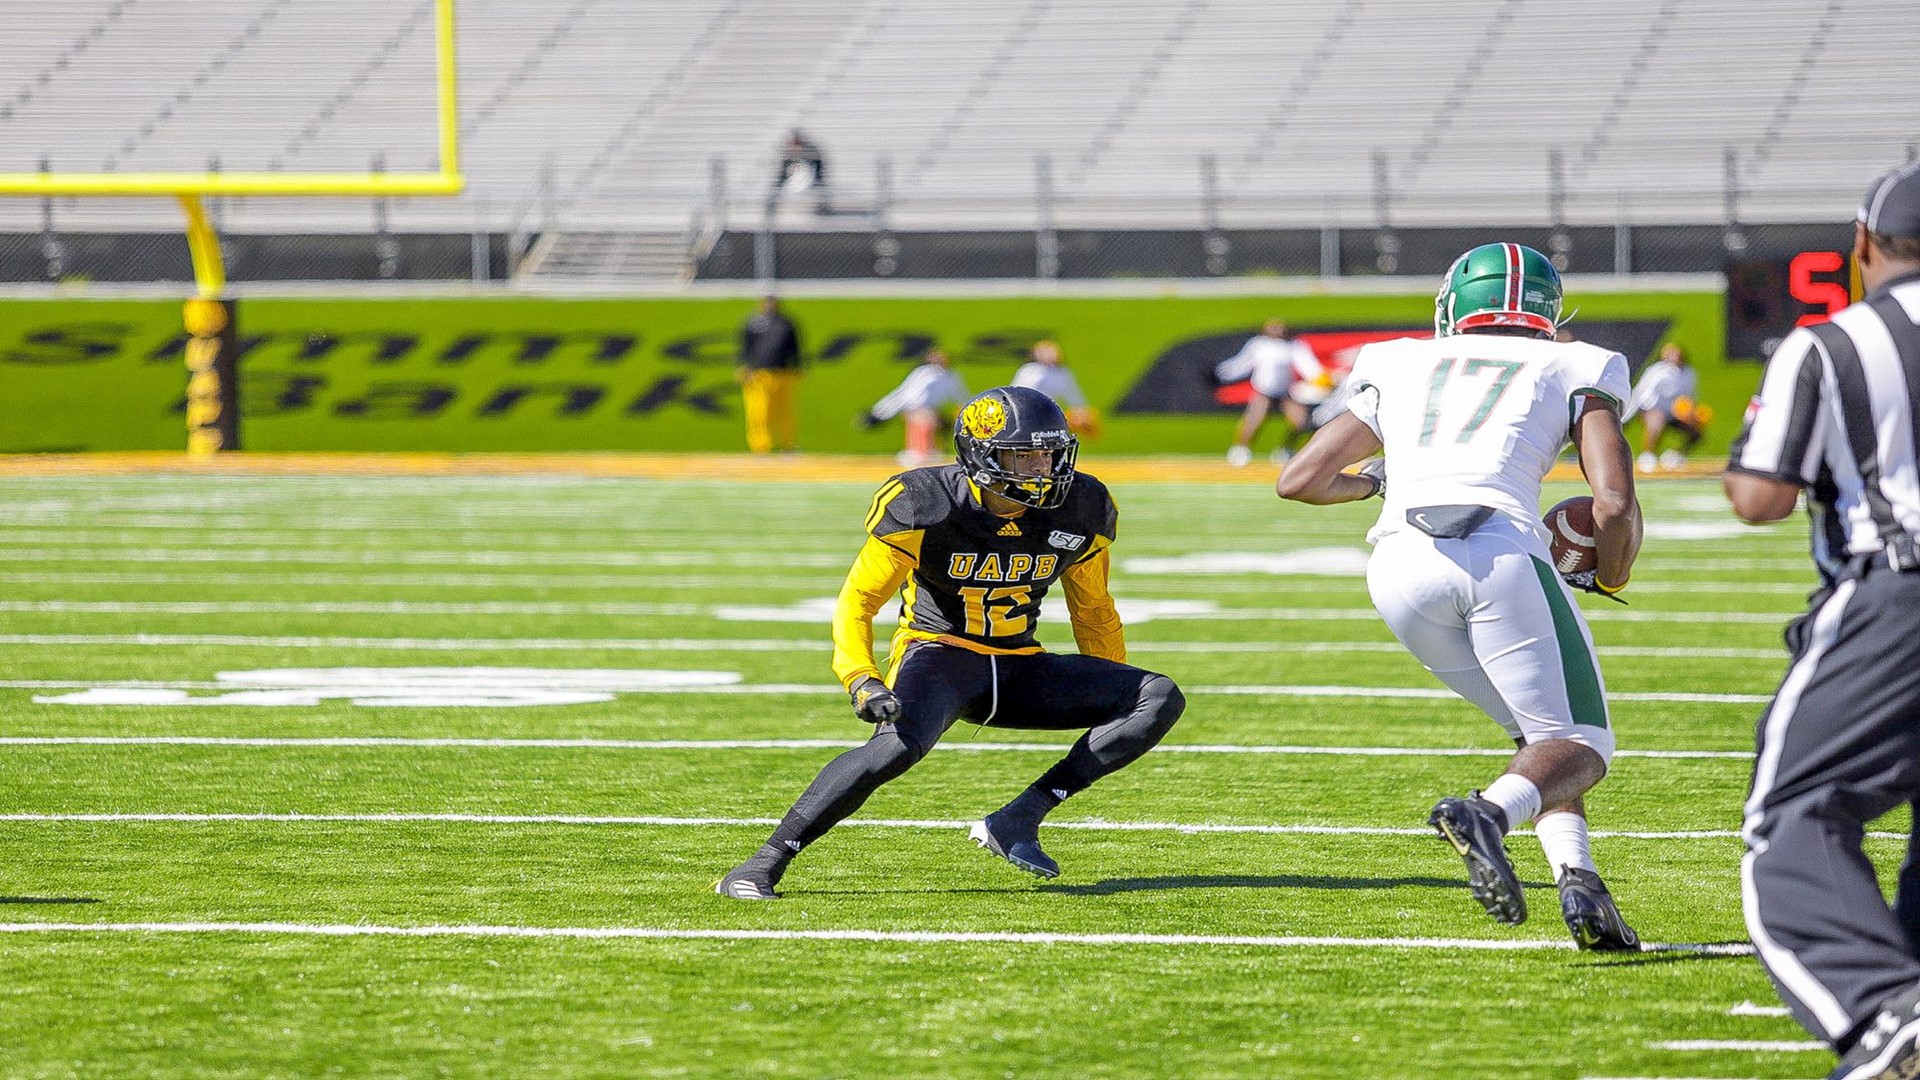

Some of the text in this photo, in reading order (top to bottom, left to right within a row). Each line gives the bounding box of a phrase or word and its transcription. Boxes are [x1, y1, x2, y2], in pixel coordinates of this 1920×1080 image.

[1417, 357, 1529, 449] 17
[948, 552, 1059, 582] UAPB
[957, 585, 1033, 638] 12
